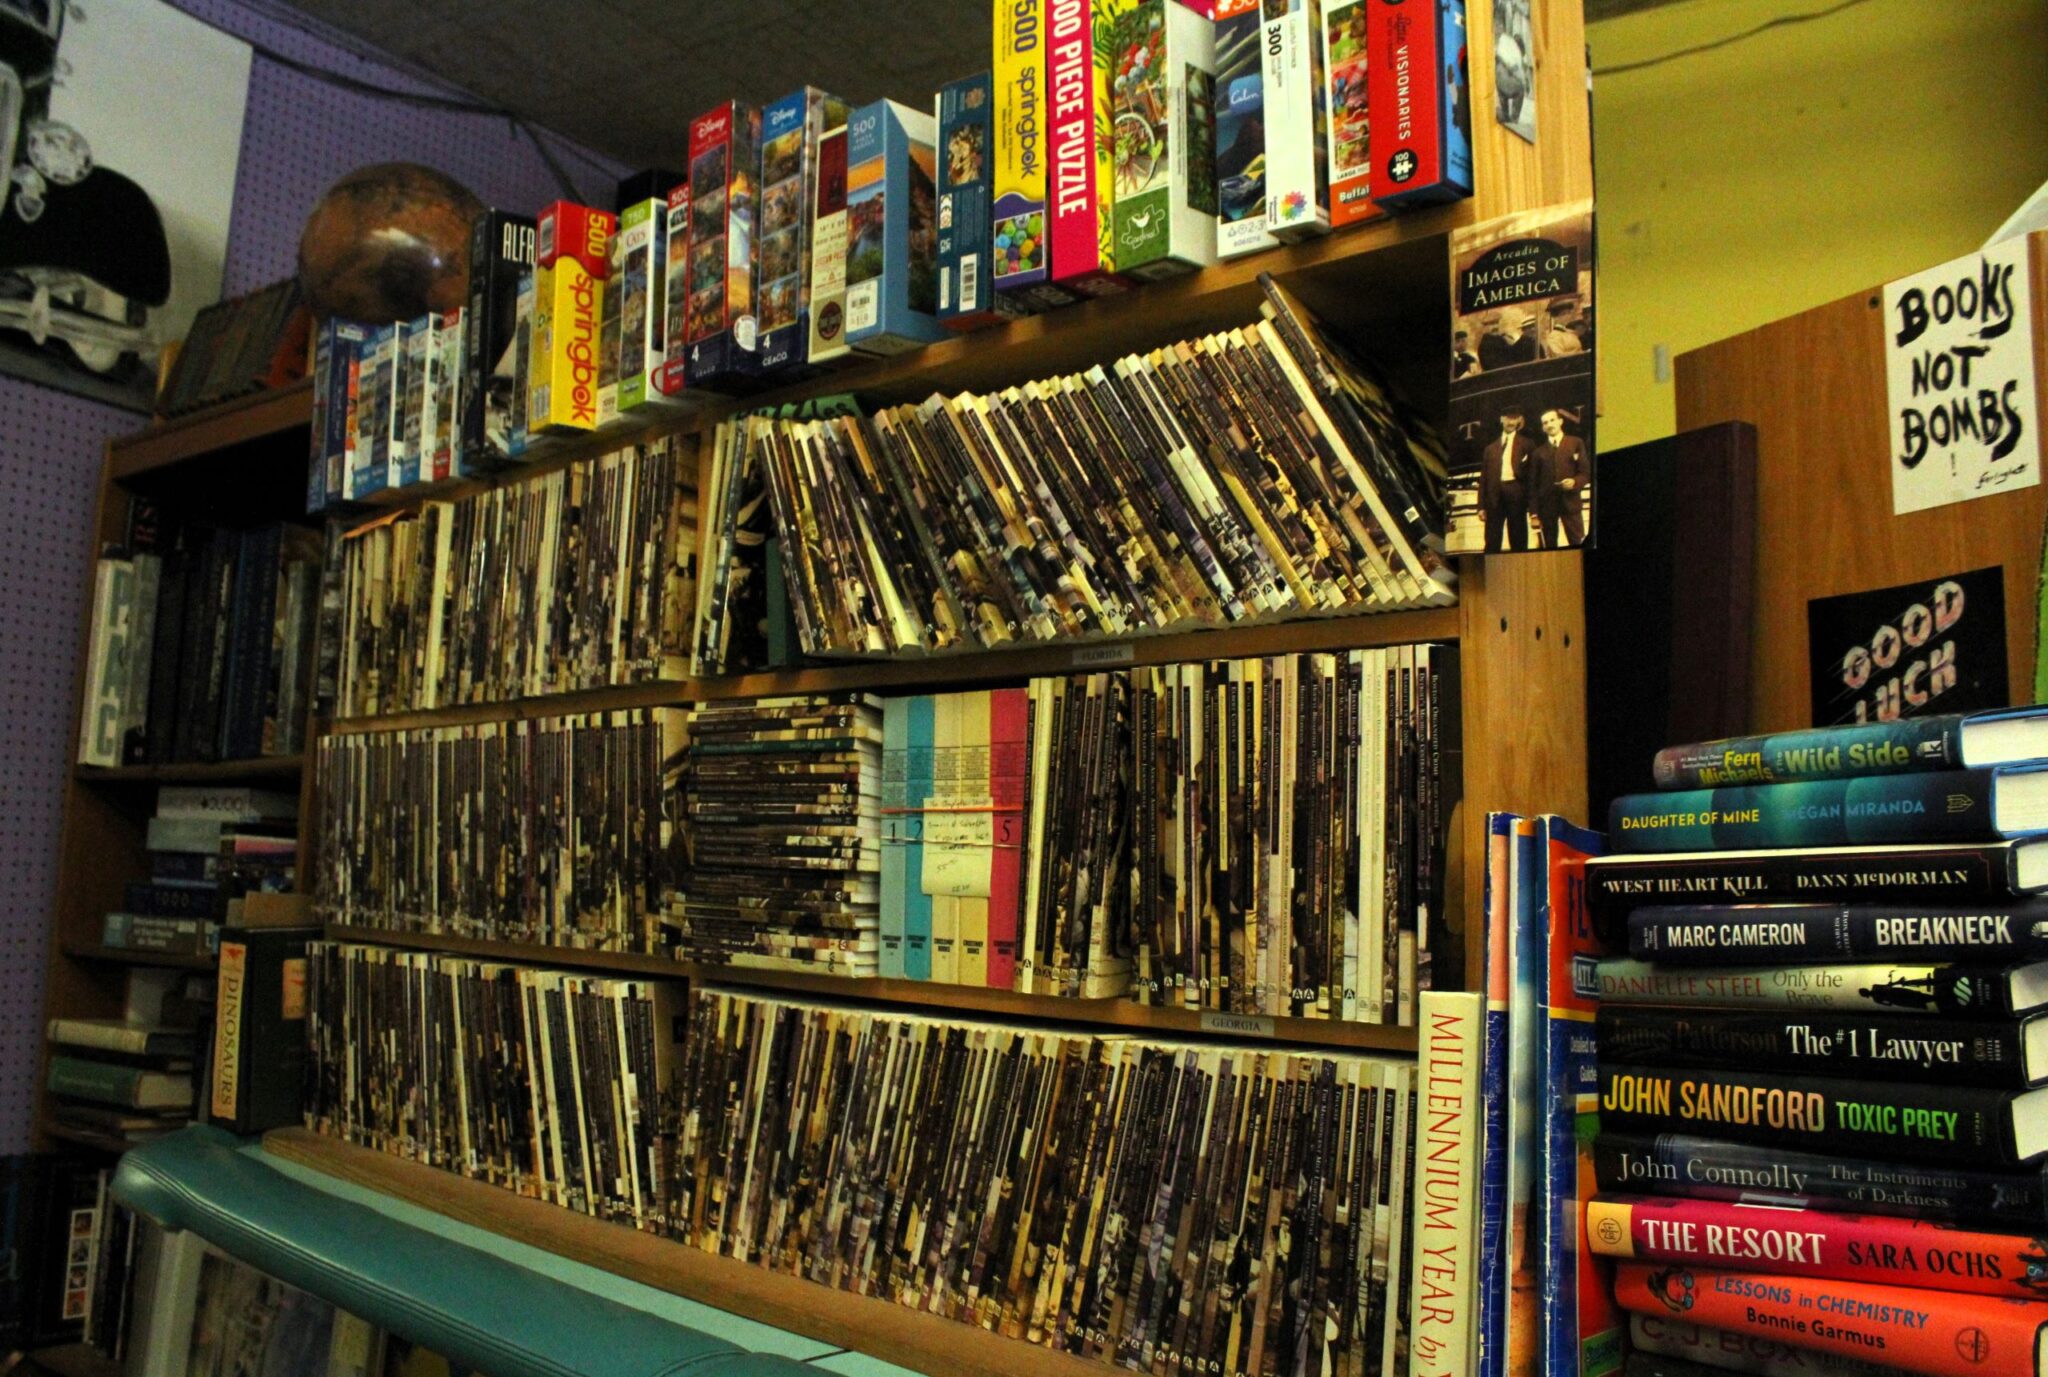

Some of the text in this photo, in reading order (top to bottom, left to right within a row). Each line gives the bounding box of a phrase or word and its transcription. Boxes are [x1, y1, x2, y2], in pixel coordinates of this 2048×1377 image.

[1268, 24, 1282, 56] 300
[1014, 0, 1038, 179] 500 springbok
[1396, 45, 1411, 140] VISIONARIES
[770, 107, 797, 126] Disney
[852, 116, 876, 137] 500
[1054, 40, 1088, 218] PIECE PUZZLE
[1395, 152, 1409, 162] 100
[502, 222, 536, 264] ALFR
[588, 213, 608, 257] 500
[1493, 243, 1541, 263] Arcadia
[1467, 255, 1570, 289] IMAGES OF
[1473, 279, 1560, 307] AMERICA
[1895, 252, 2014, 348] BOOKS
[566, 272, 598, 422] springbok
[692, 345, 699, 361] 4
[763, 334, 771, 349] 4
[1912, 345, 1991, 398] NOT
[1899, 378, 2023, 469] BOMBS
[1843, 581, 1965, 689] GOOD
[1432, 752, 1440, 776] CRIME
[1724, 749, 1762, 770] Fern
[1784, 741, 1910, 773] Wild Side
[1699, 766, 1774, 785] Michaels
[1622, 809, 1760, 830] DAUGHTER OF MINE
[1783, 799, 1926, 820] MEGAN MIRANDA
[889, 821, 897, 844] 1
[1000, 819, 1012, 843] 5
[1603, 875, 1768, 897] WEST HEART KILL
[1797, 874, 1848, 888] DANN
[1667, 925, 1715, 947] MARC
[1719, 923, 1805, 947] CAMERON
[1876, 915, 2014, 946] BREAKNECK
[1602, 974, 1768, 998] DANIELLE STEEL
[1772, 969, 1843, 990] Only the
[1212, 1018, 1261, 1032] GEORGIA
[220, 977, 239, 1106] DINOSAURS
[1785, 1025, 1964, 1068] The #1 Lawyer
[1603, 1074, 1825, 1133] JOHN SANDFORD
[1836, 1101, 1958, 1141] TOXIC PREY
[1414, 1012, 1464, 1365] MILLENNIUM YEAR by
[1617, 1153, 1808, 1197] John Connolly
[1827, 1164, 1967, 1190] The Instruments
[1847, 1185, 1950, 1208] of Darkness
[1641, 1219, 1826, 1265] THE RESORT
[1847, 1240, 2003, 1280] SARA OCHS
[1714, 1275, 1930, 1330] LESSONS in CHEMISTRY
[1746, 1307, 1887, 1350] Bonnie Garmus
